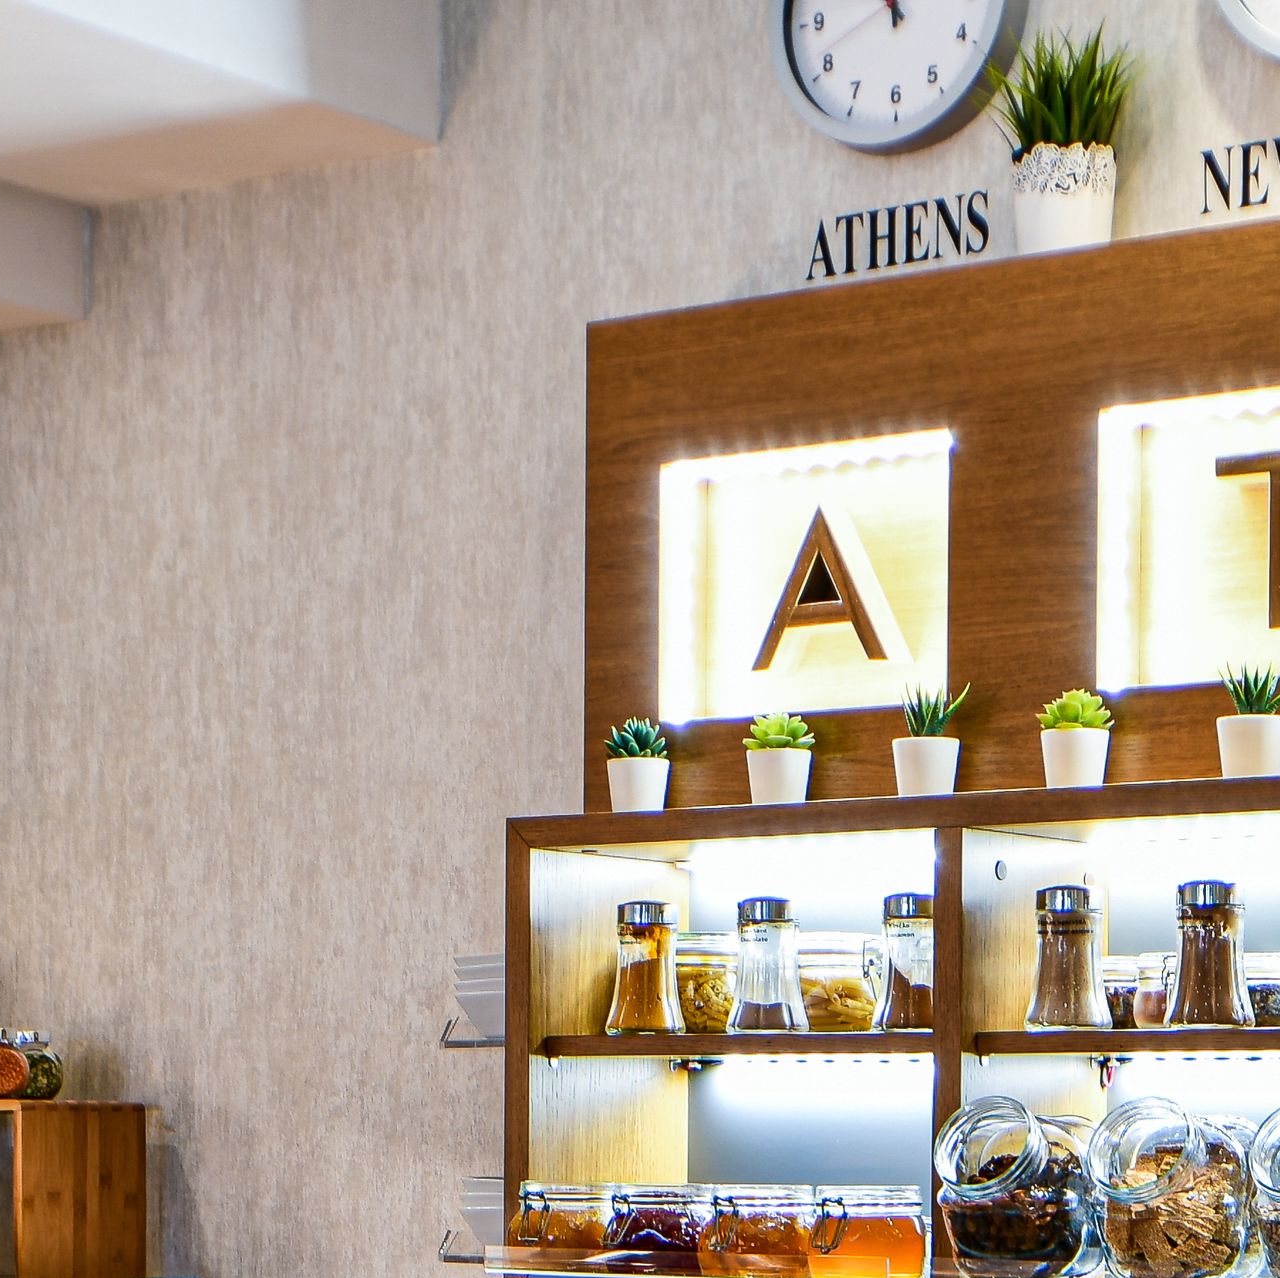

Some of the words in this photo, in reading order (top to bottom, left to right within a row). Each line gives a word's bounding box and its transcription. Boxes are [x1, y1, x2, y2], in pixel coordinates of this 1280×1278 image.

[813, 12, 825, 31] 9
[955, 22, 967, 42] 4
[822, 53, 834, 73] 8
[926, 64, 938, 84] 5
[850, 80, 862, 100] 7
[890, 84, 902, 104] 6
[805, 189, 991, 281] ATHENS
[752, 504, 889, 671] A
